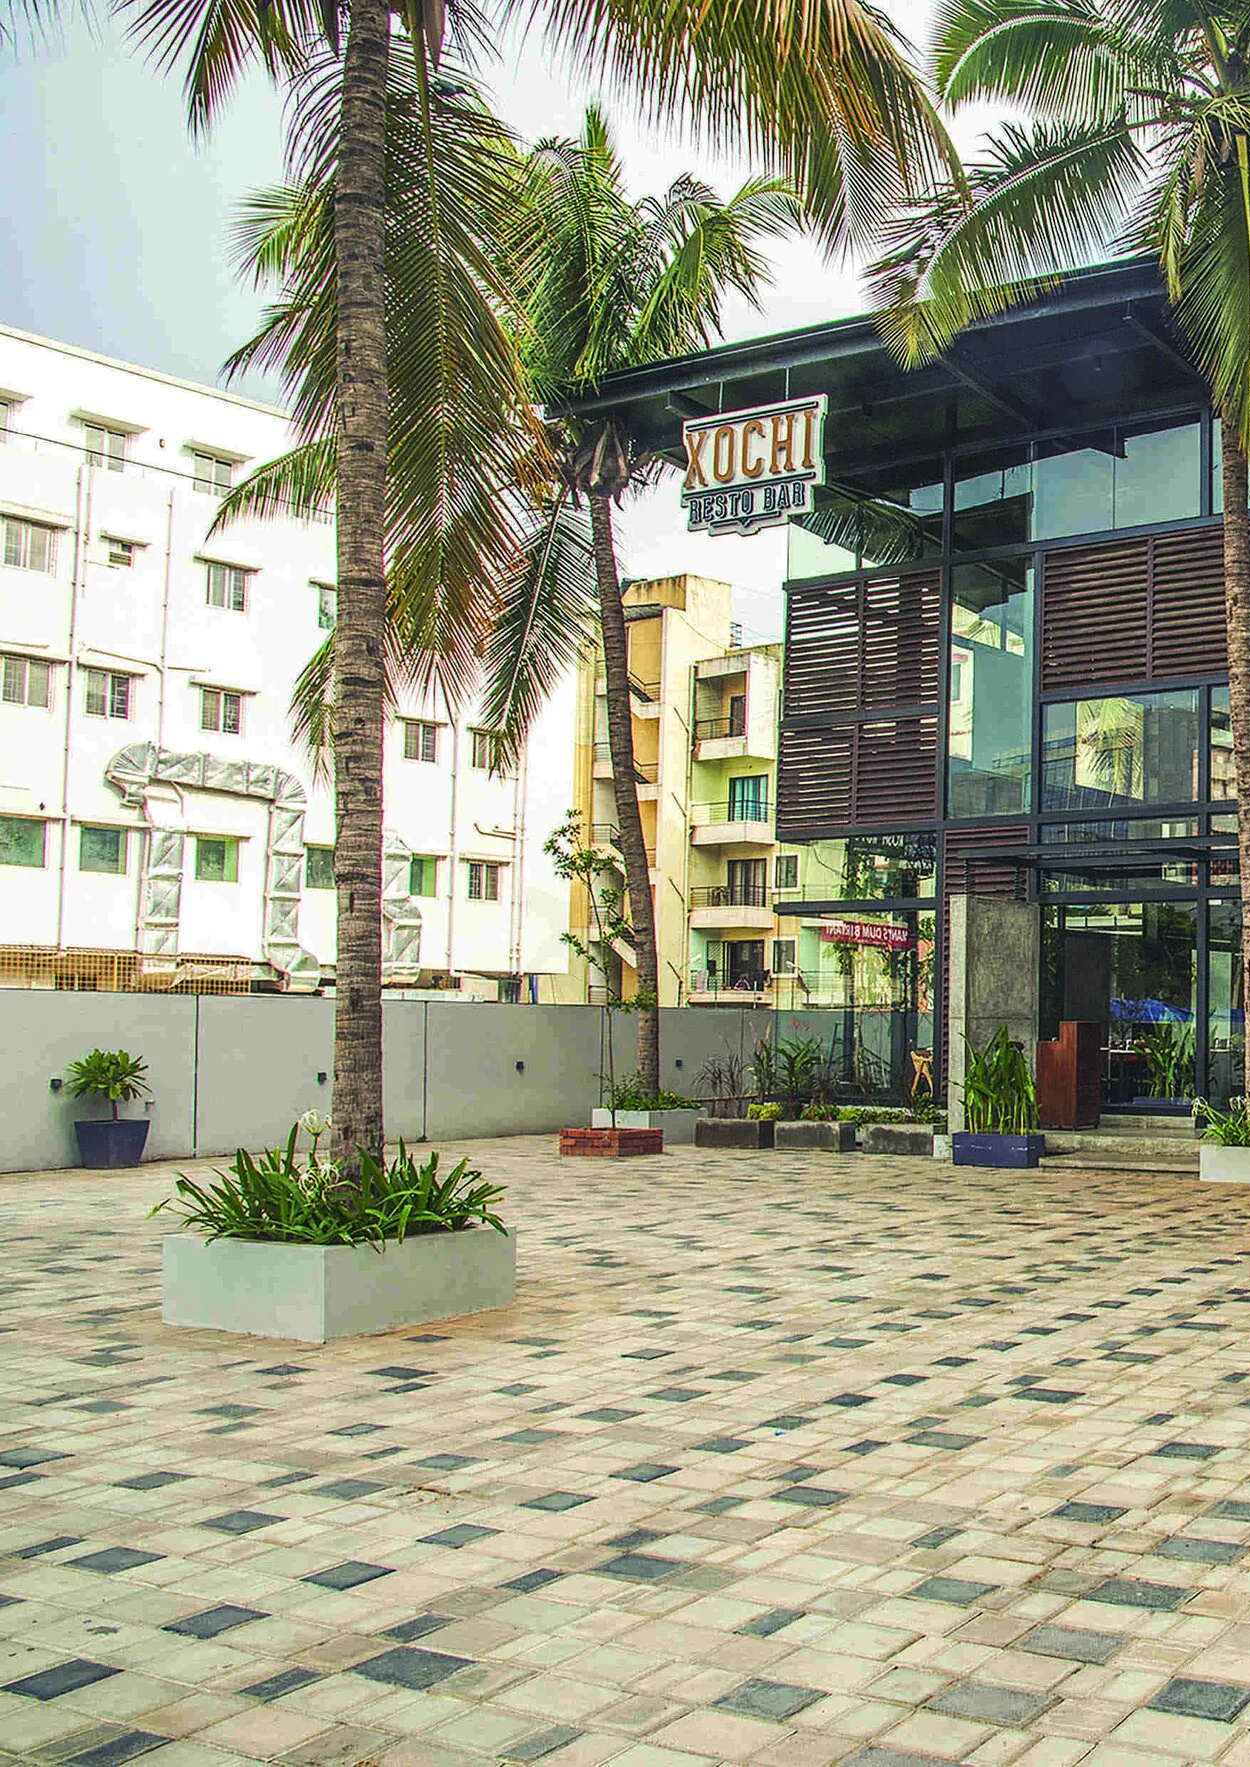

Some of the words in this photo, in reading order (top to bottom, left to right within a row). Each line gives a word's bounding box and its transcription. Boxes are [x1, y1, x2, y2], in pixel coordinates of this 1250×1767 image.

[684, 410, 816, 490] XOCHI
[689, 490, 754, 524] RESTO
[763, 481, 806, 512] BAR
